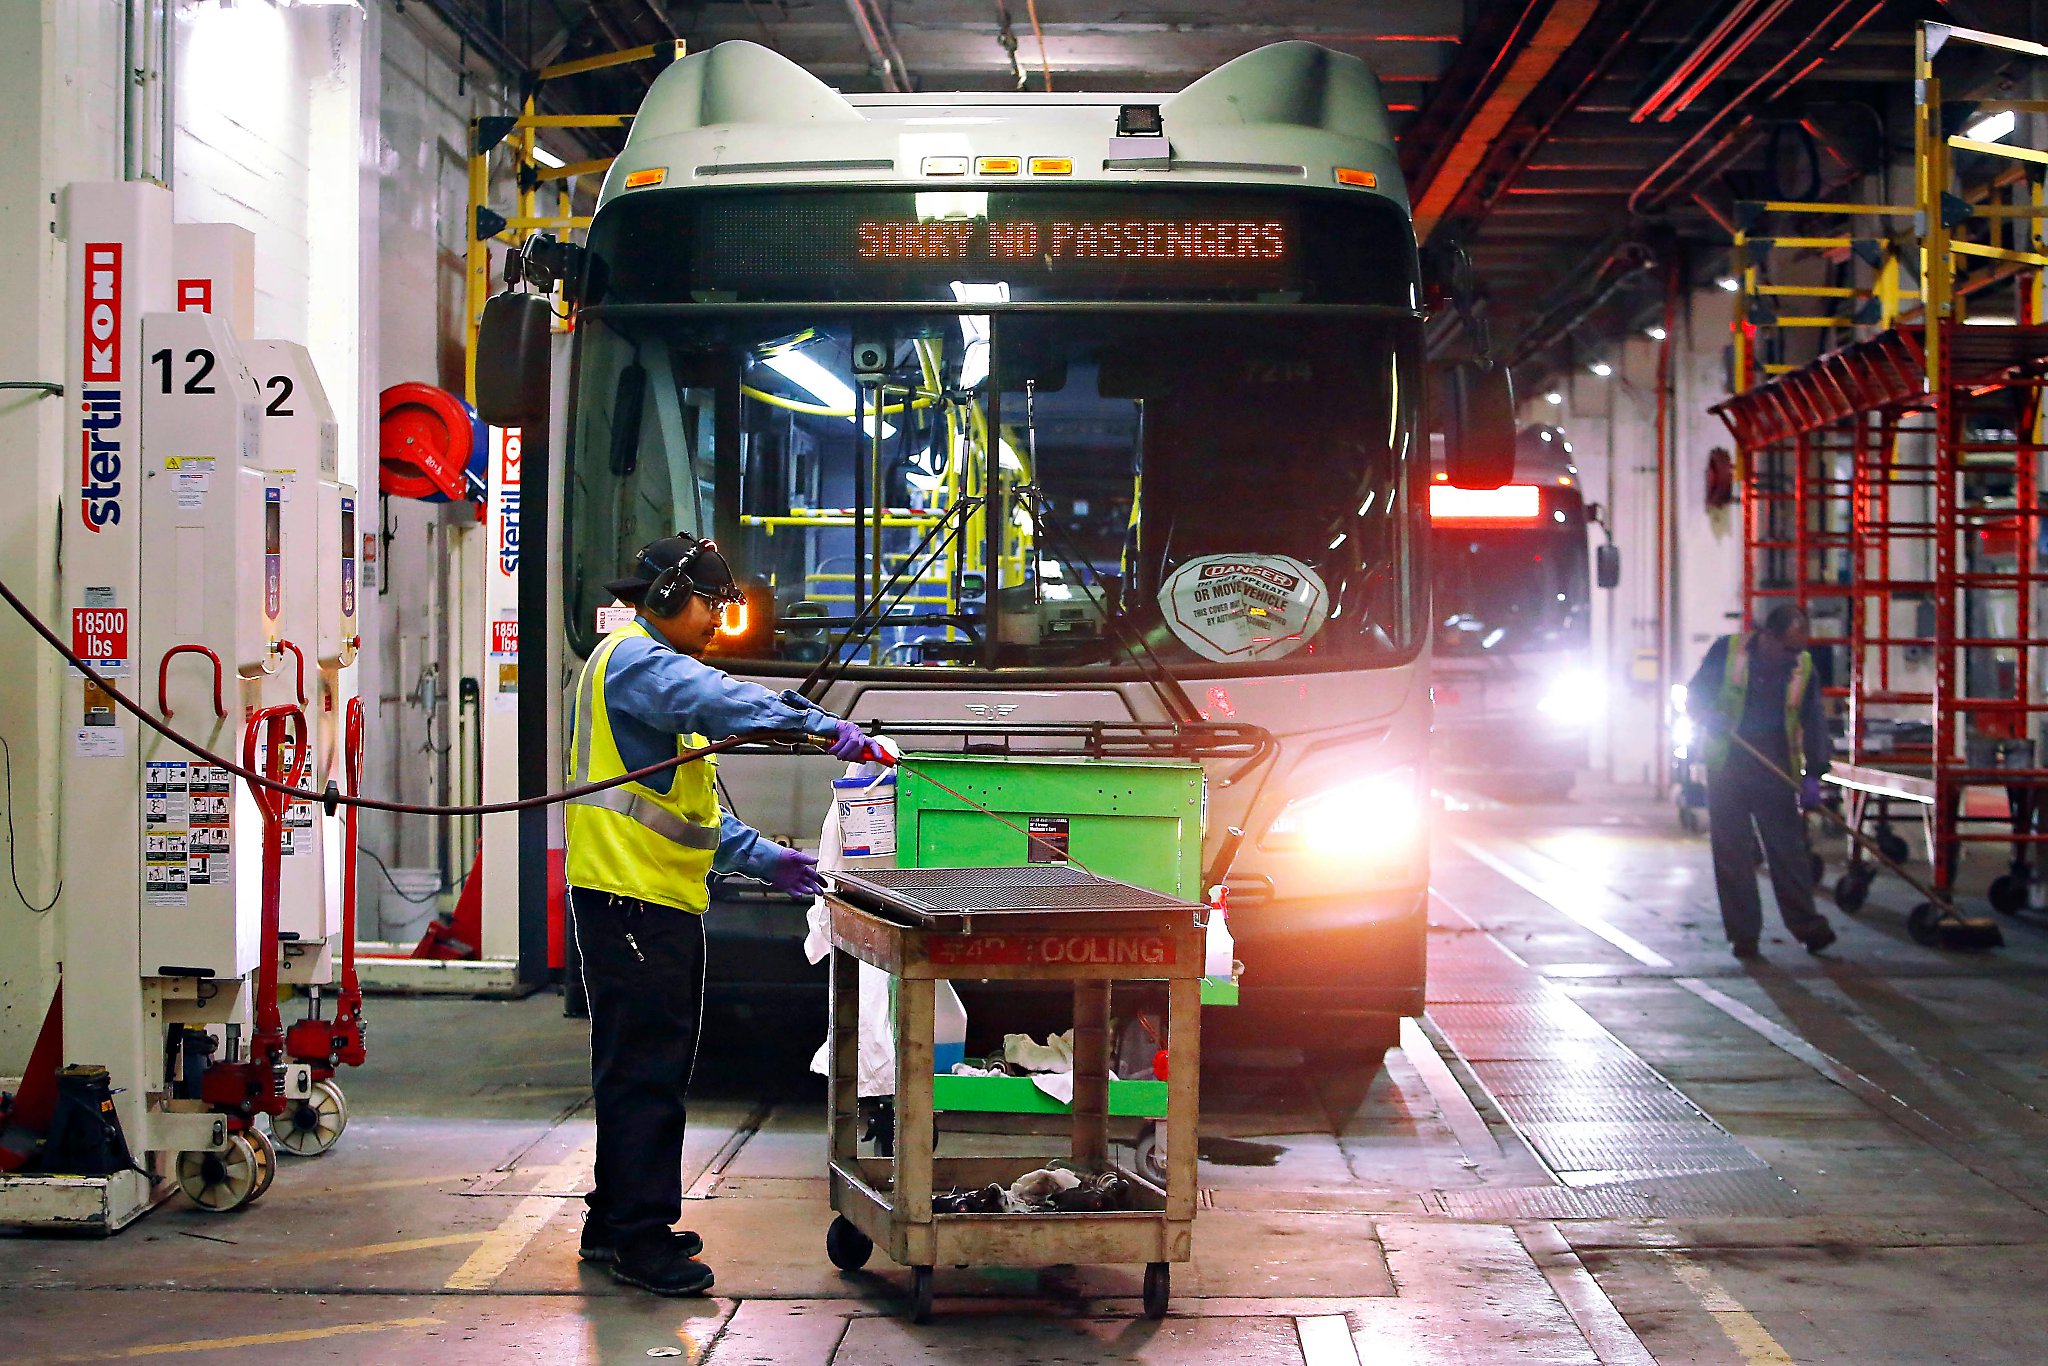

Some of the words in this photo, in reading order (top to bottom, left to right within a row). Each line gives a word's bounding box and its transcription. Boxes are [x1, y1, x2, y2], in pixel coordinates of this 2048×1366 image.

[858, 222, 974, 257] SORRY
[988, 222, 1039, 257] NO
[1052, 222, 1285, 258] PASSENGERS
[91, 251, 115, 374] KONI
[151, 348, 216, 395] 12
[81, 390, 122, 534] stertil
[1211, 566, 1288, 587] DANGER
[1240, 576, 1290, 597] OPERATE
[1194, 588, 1211, 603] OR
[1243, 585, 1289, 609] VEHICLE
[1208, 602, 1229, 615] COVER
[76, 612, 125, 634] 18500
[494, 623, 519, 637] 1850
[87, 634, 113, 657] lbs
